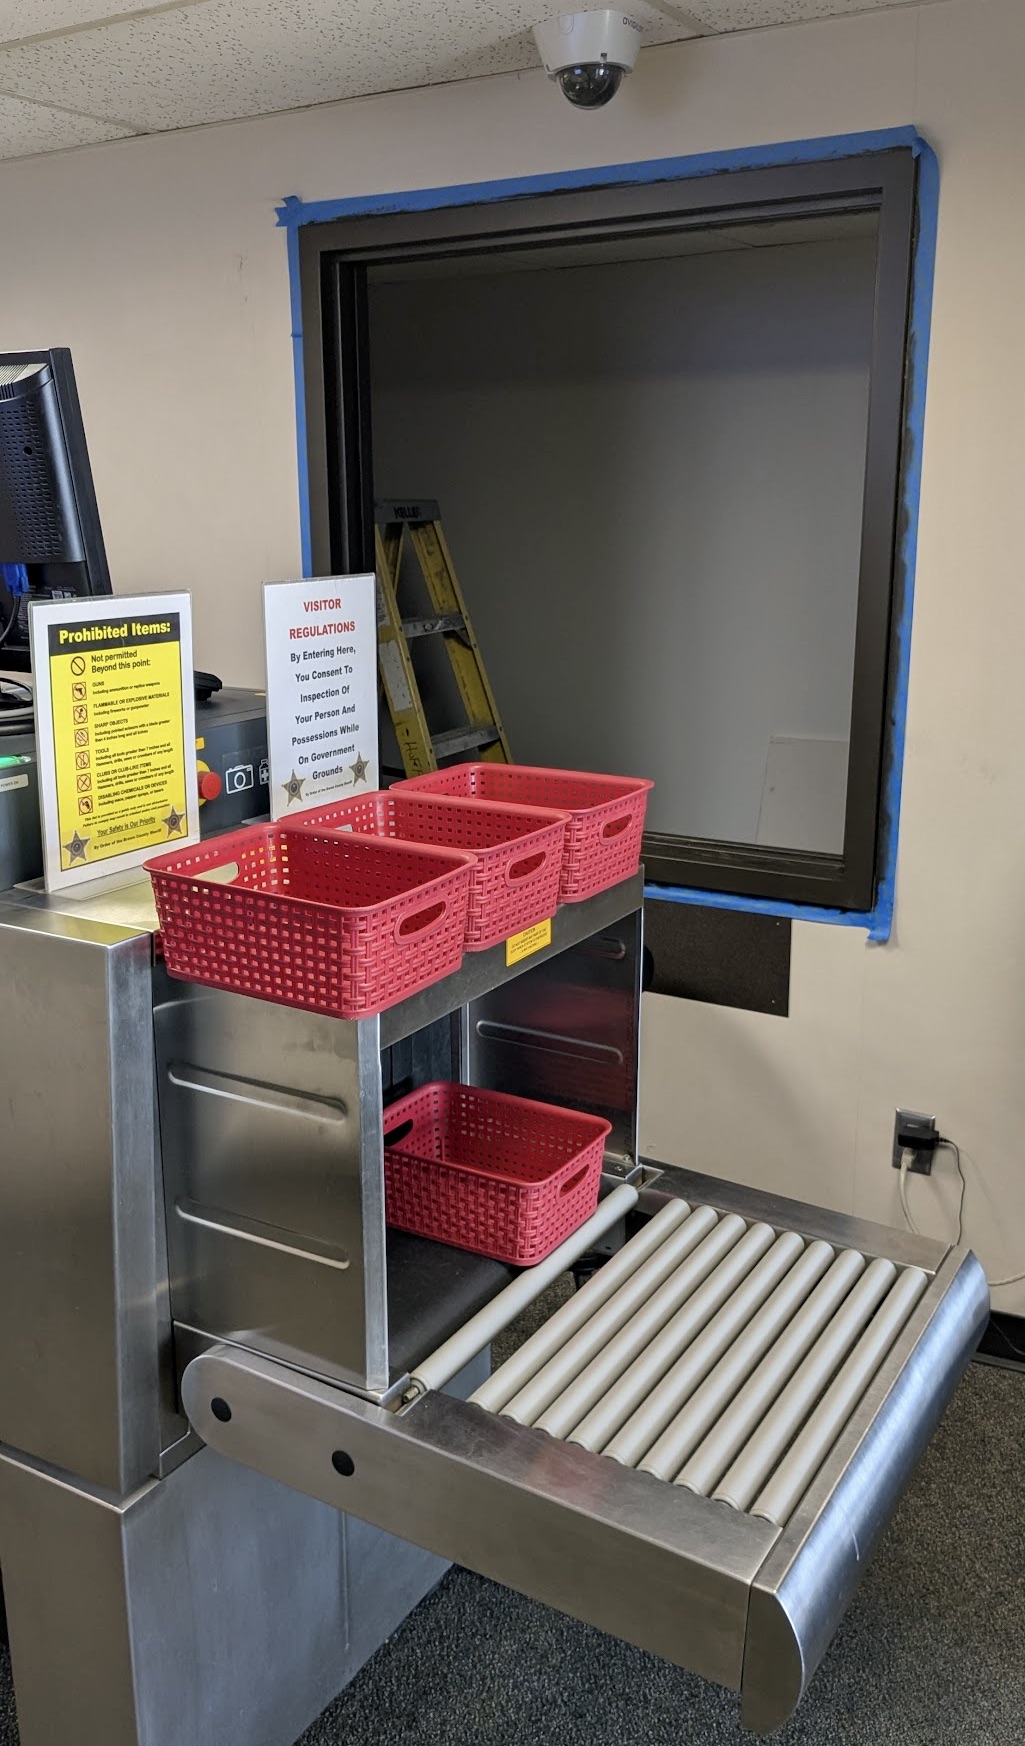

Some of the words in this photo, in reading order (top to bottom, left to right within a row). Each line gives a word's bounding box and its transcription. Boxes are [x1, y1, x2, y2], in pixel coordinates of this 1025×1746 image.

[303, 599, 341, 612] VISITOR
[59, 624, 128, 644] Prohibited
[132, 622, 170, 636] Items:
[290, 621, 355, 640] REGULATIONS
[105, 650, 138, 662] permitted
[290, 653, 300, 663] By
[303, 649, 334, 660] Entering
[337, 646, 356, 655] Here,
[92, 664, 116, 674] Beyond
[119, 661, 131, 670] this
[133, 659, 151, 670] point:
[295, 674, 309, 682] You
[312, 668, 342, 680] Consent
[344, 665, 352, 674] To
[301, 689, 339, 702] Inspection
[342, 685, 350, 694] Of
[295, 715, 312, 724] Your
[315, 710, 339, 720] Person
[342, 704, 355, 714] And
[292, 729, 337, 746] Possessions
[340, 724, 359, 734] While
[298, 756, 308, 764] On
[311, 744, 355, 761] Government
[118, 765, 139, 773] CLUB-LIKE
[312, 765, 343, 779] Grounds
[98, 791, 120, 800] DISABLING
[121, 786, 143, 794] CHEMICALS
[109, 825, 123, 834] Safety
[140, 817, 156, 826] Priority
